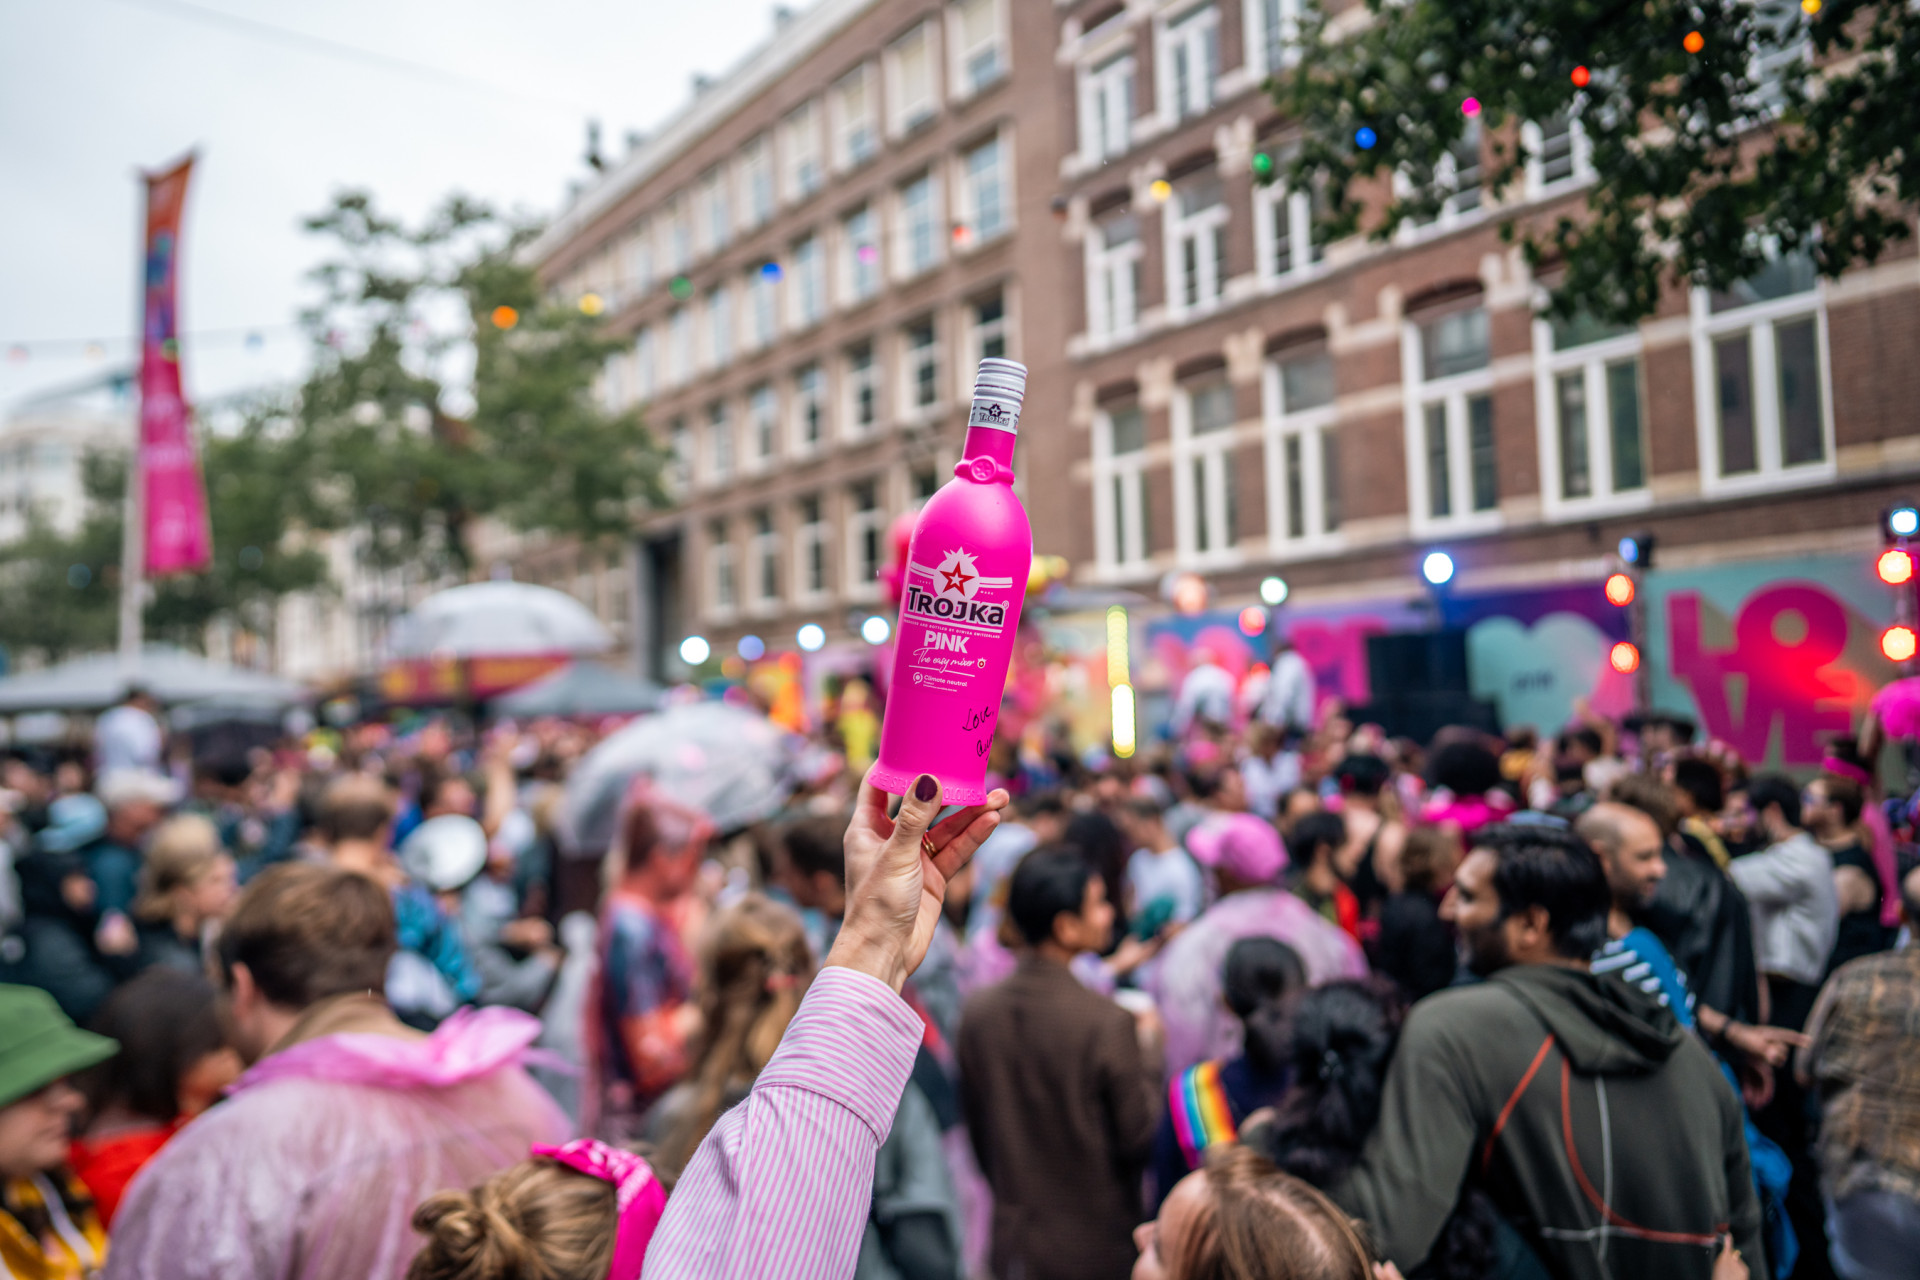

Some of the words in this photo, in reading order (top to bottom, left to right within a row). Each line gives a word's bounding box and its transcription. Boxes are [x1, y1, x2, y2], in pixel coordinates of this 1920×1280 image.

[924, 630, 970, 654] PINK
[913, 648, 934, 664] The
[933, 657, 950, 674] easy
[950, 657, 975, 667] mixer
[924, 674, 946, 684] Climate
[947, 679, 968, 687] neutral
